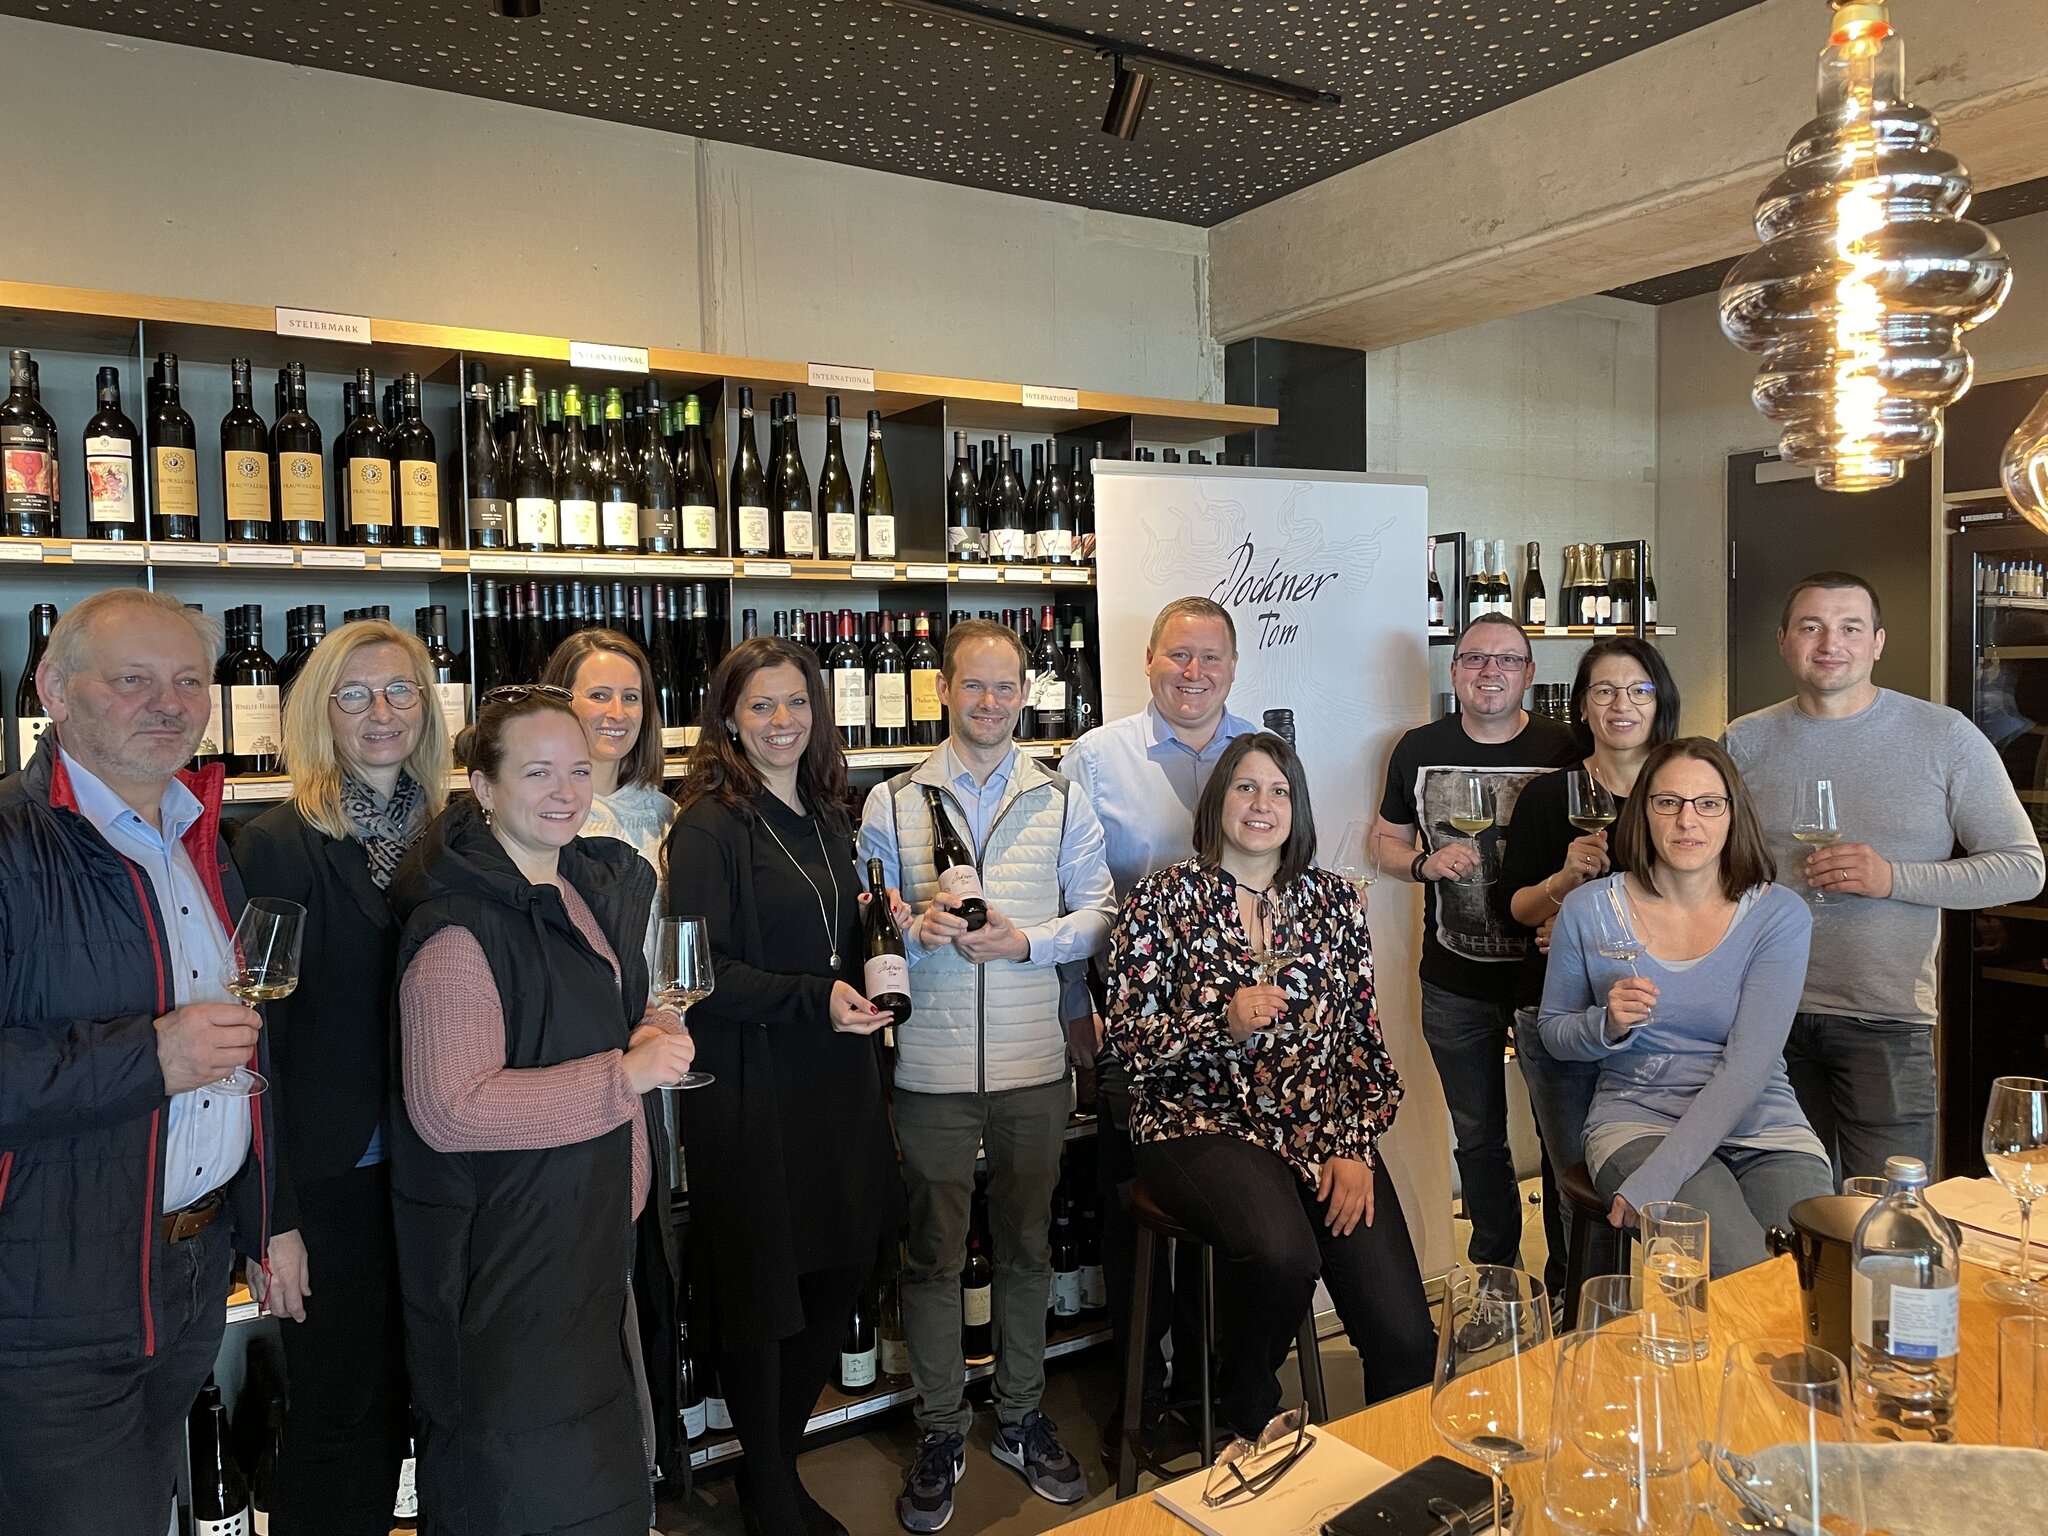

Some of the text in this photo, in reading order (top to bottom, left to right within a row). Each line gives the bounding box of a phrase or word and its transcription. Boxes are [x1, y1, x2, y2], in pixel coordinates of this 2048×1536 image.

[289, 319, 359, 334] STEIERMARK
[812, 372, 871, 385] INTERNATIONAL
[1025, 392, 1076, 403] INTERNATIONAL
[1208, 532, 1339, 608] Dockner
[1258, 610, 1299, 650] Tom
